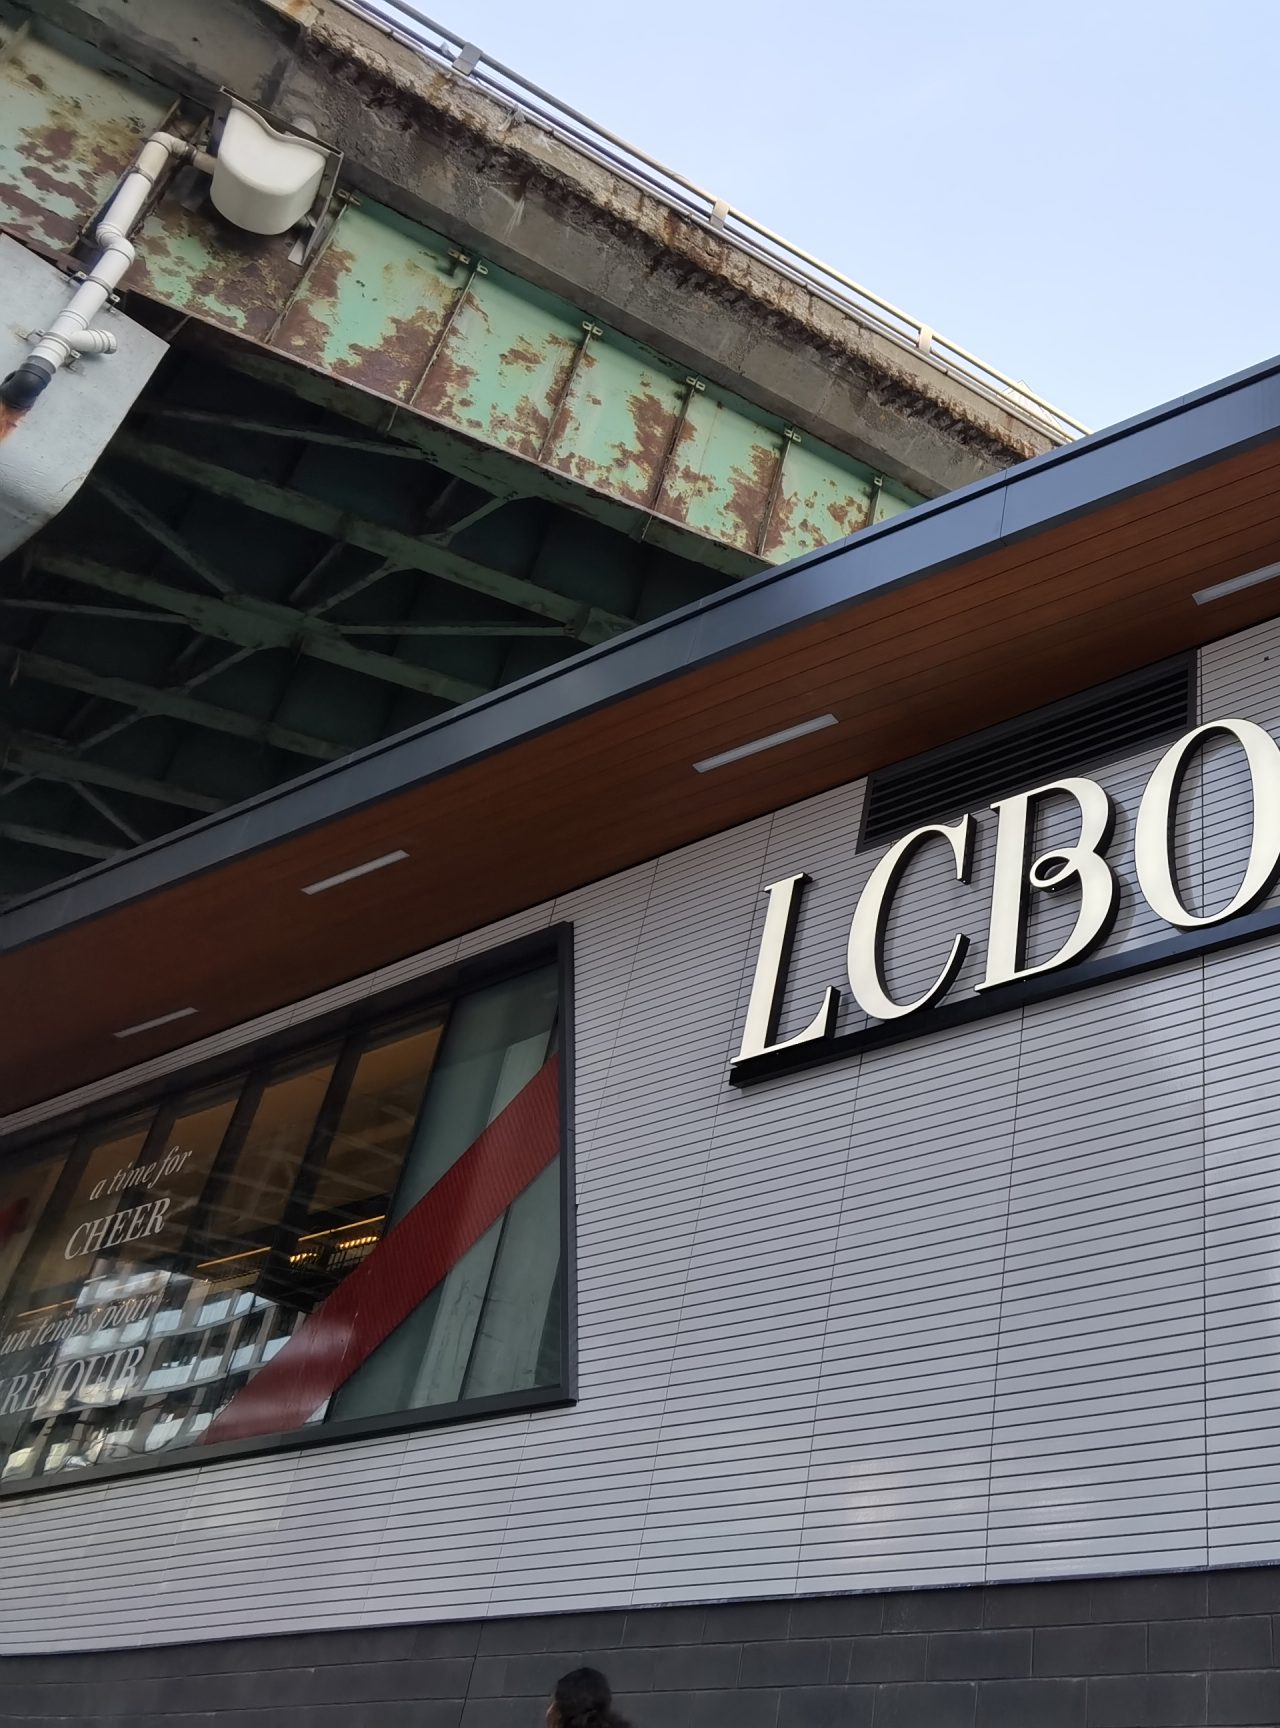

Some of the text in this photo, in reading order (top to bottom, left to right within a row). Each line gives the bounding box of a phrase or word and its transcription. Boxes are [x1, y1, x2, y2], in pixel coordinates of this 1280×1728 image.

[89, 1145, 193, 1201] a time for
[64, 1197, 171, 1260] CHEER
[31, 1311, 98, 1348] temps
[97, 1294, 158, 1333] pour
